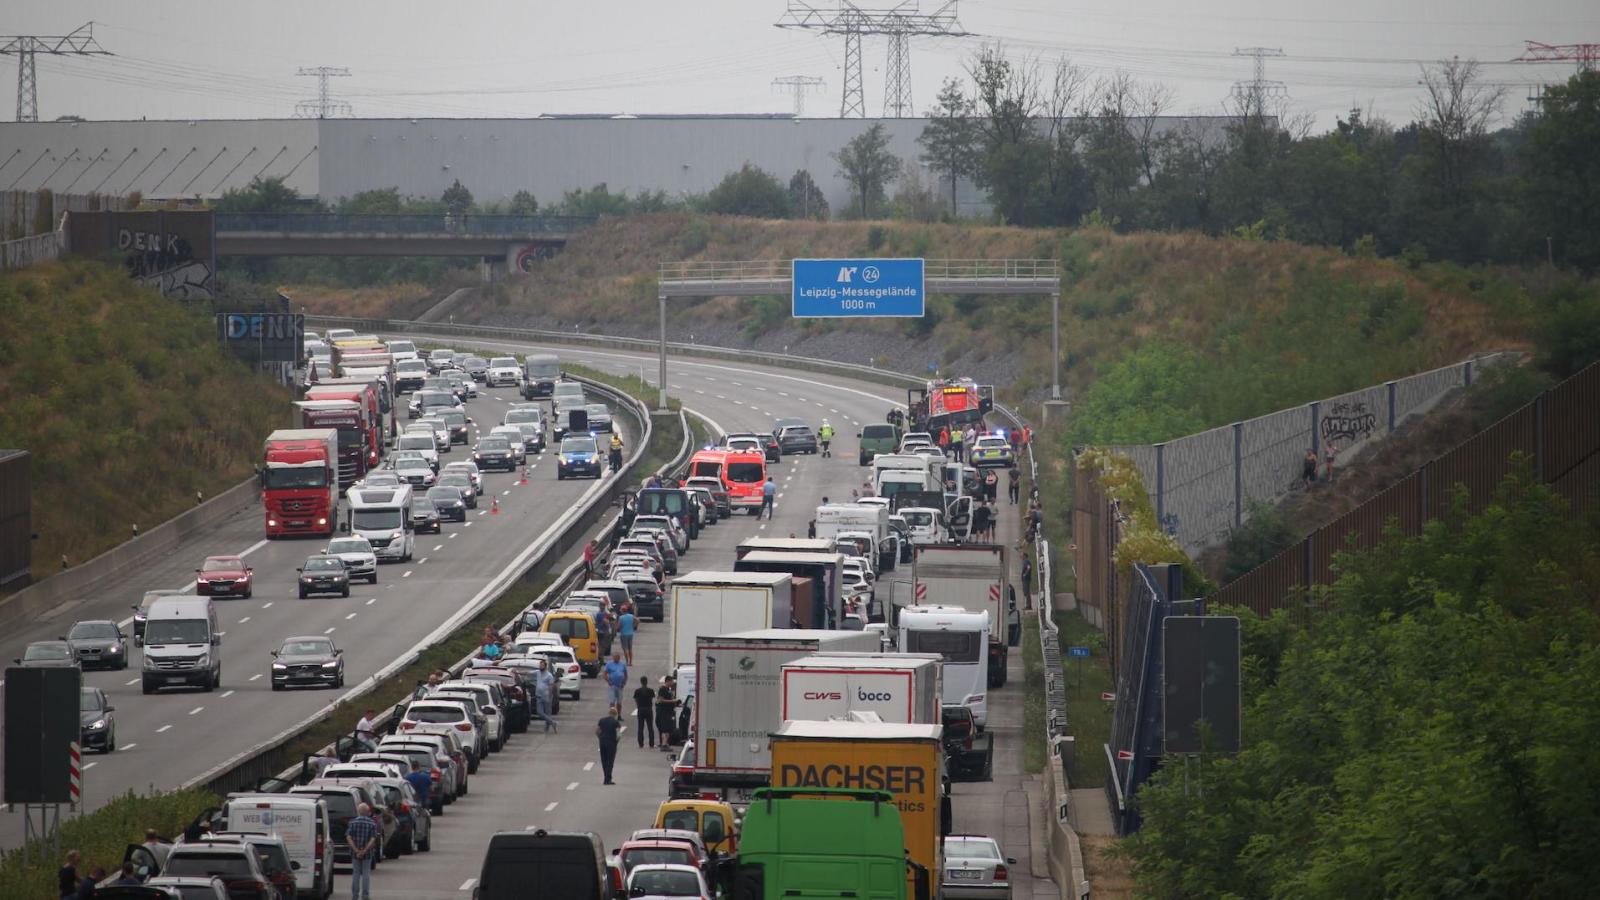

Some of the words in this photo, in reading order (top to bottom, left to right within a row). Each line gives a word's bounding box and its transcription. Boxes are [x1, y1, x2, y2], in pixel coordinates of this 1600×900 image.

[118, 229, 179, 254] DENK
[865, 269, 878, 280] 24
[800, 287, 916, 298] Leipzig-Messegelände
[841, 300, 864, 310] 1000
[866, 301, 876, 310] m
[228, 314, 304, 339] DENK
[803, 692, 842, 700] CWS
[858, 686, 892, 701] boco
[781, 764, 925, 794] DACHSER
[243, 814, 260, 824] WEB
[275, 815, 302, 824] PHONE
